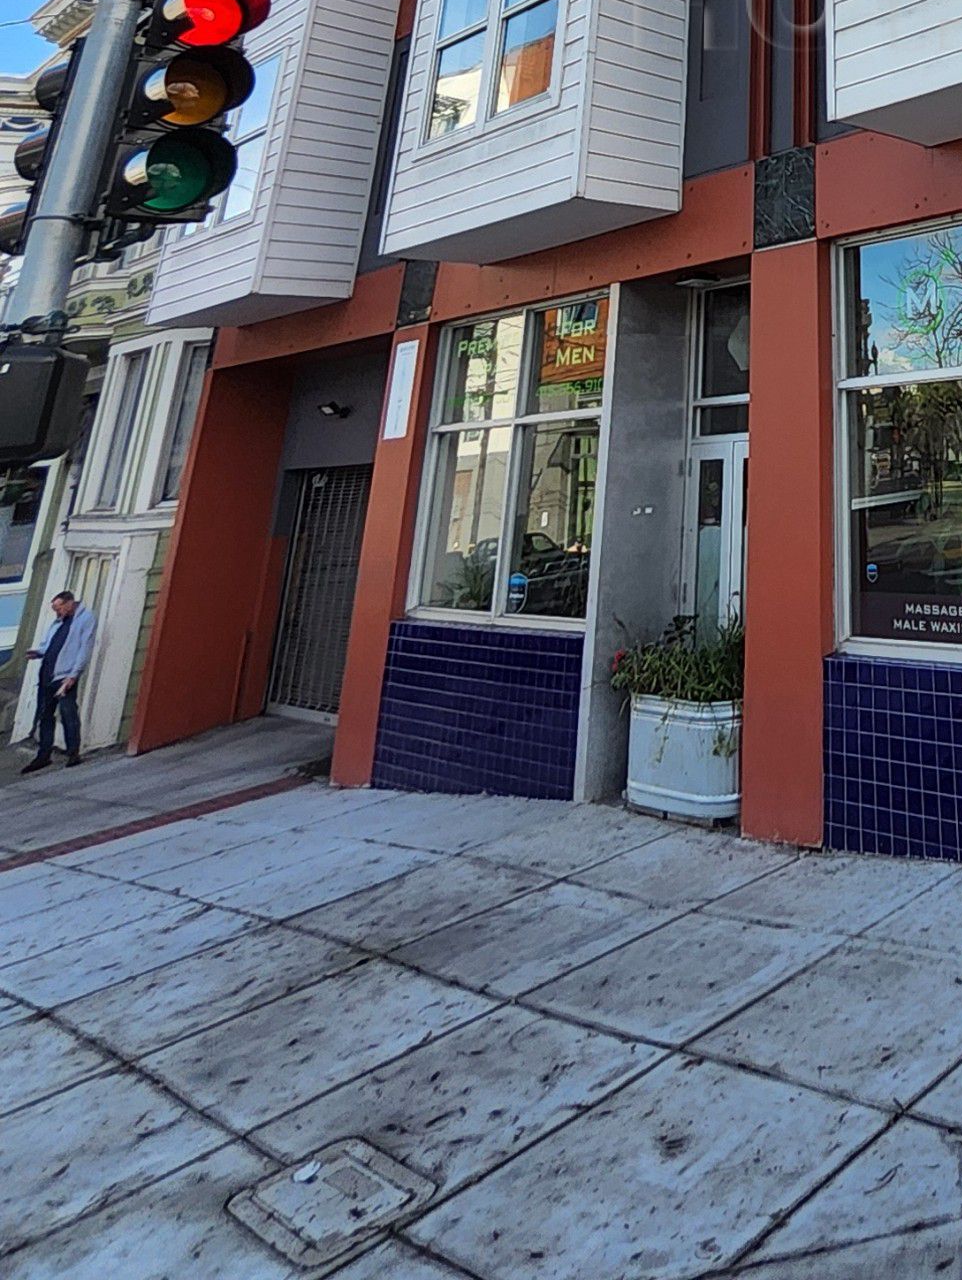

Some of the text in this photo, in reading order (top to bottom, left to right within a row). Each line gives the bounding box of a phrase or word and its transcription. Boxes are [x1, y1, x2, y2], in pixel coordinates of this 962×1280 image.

[905, 281, 938, 318] M
[559, 319, 596, 339] FOR
[555, 344, 595, 368] MEN
[893, 620, 927, 632] MALE
